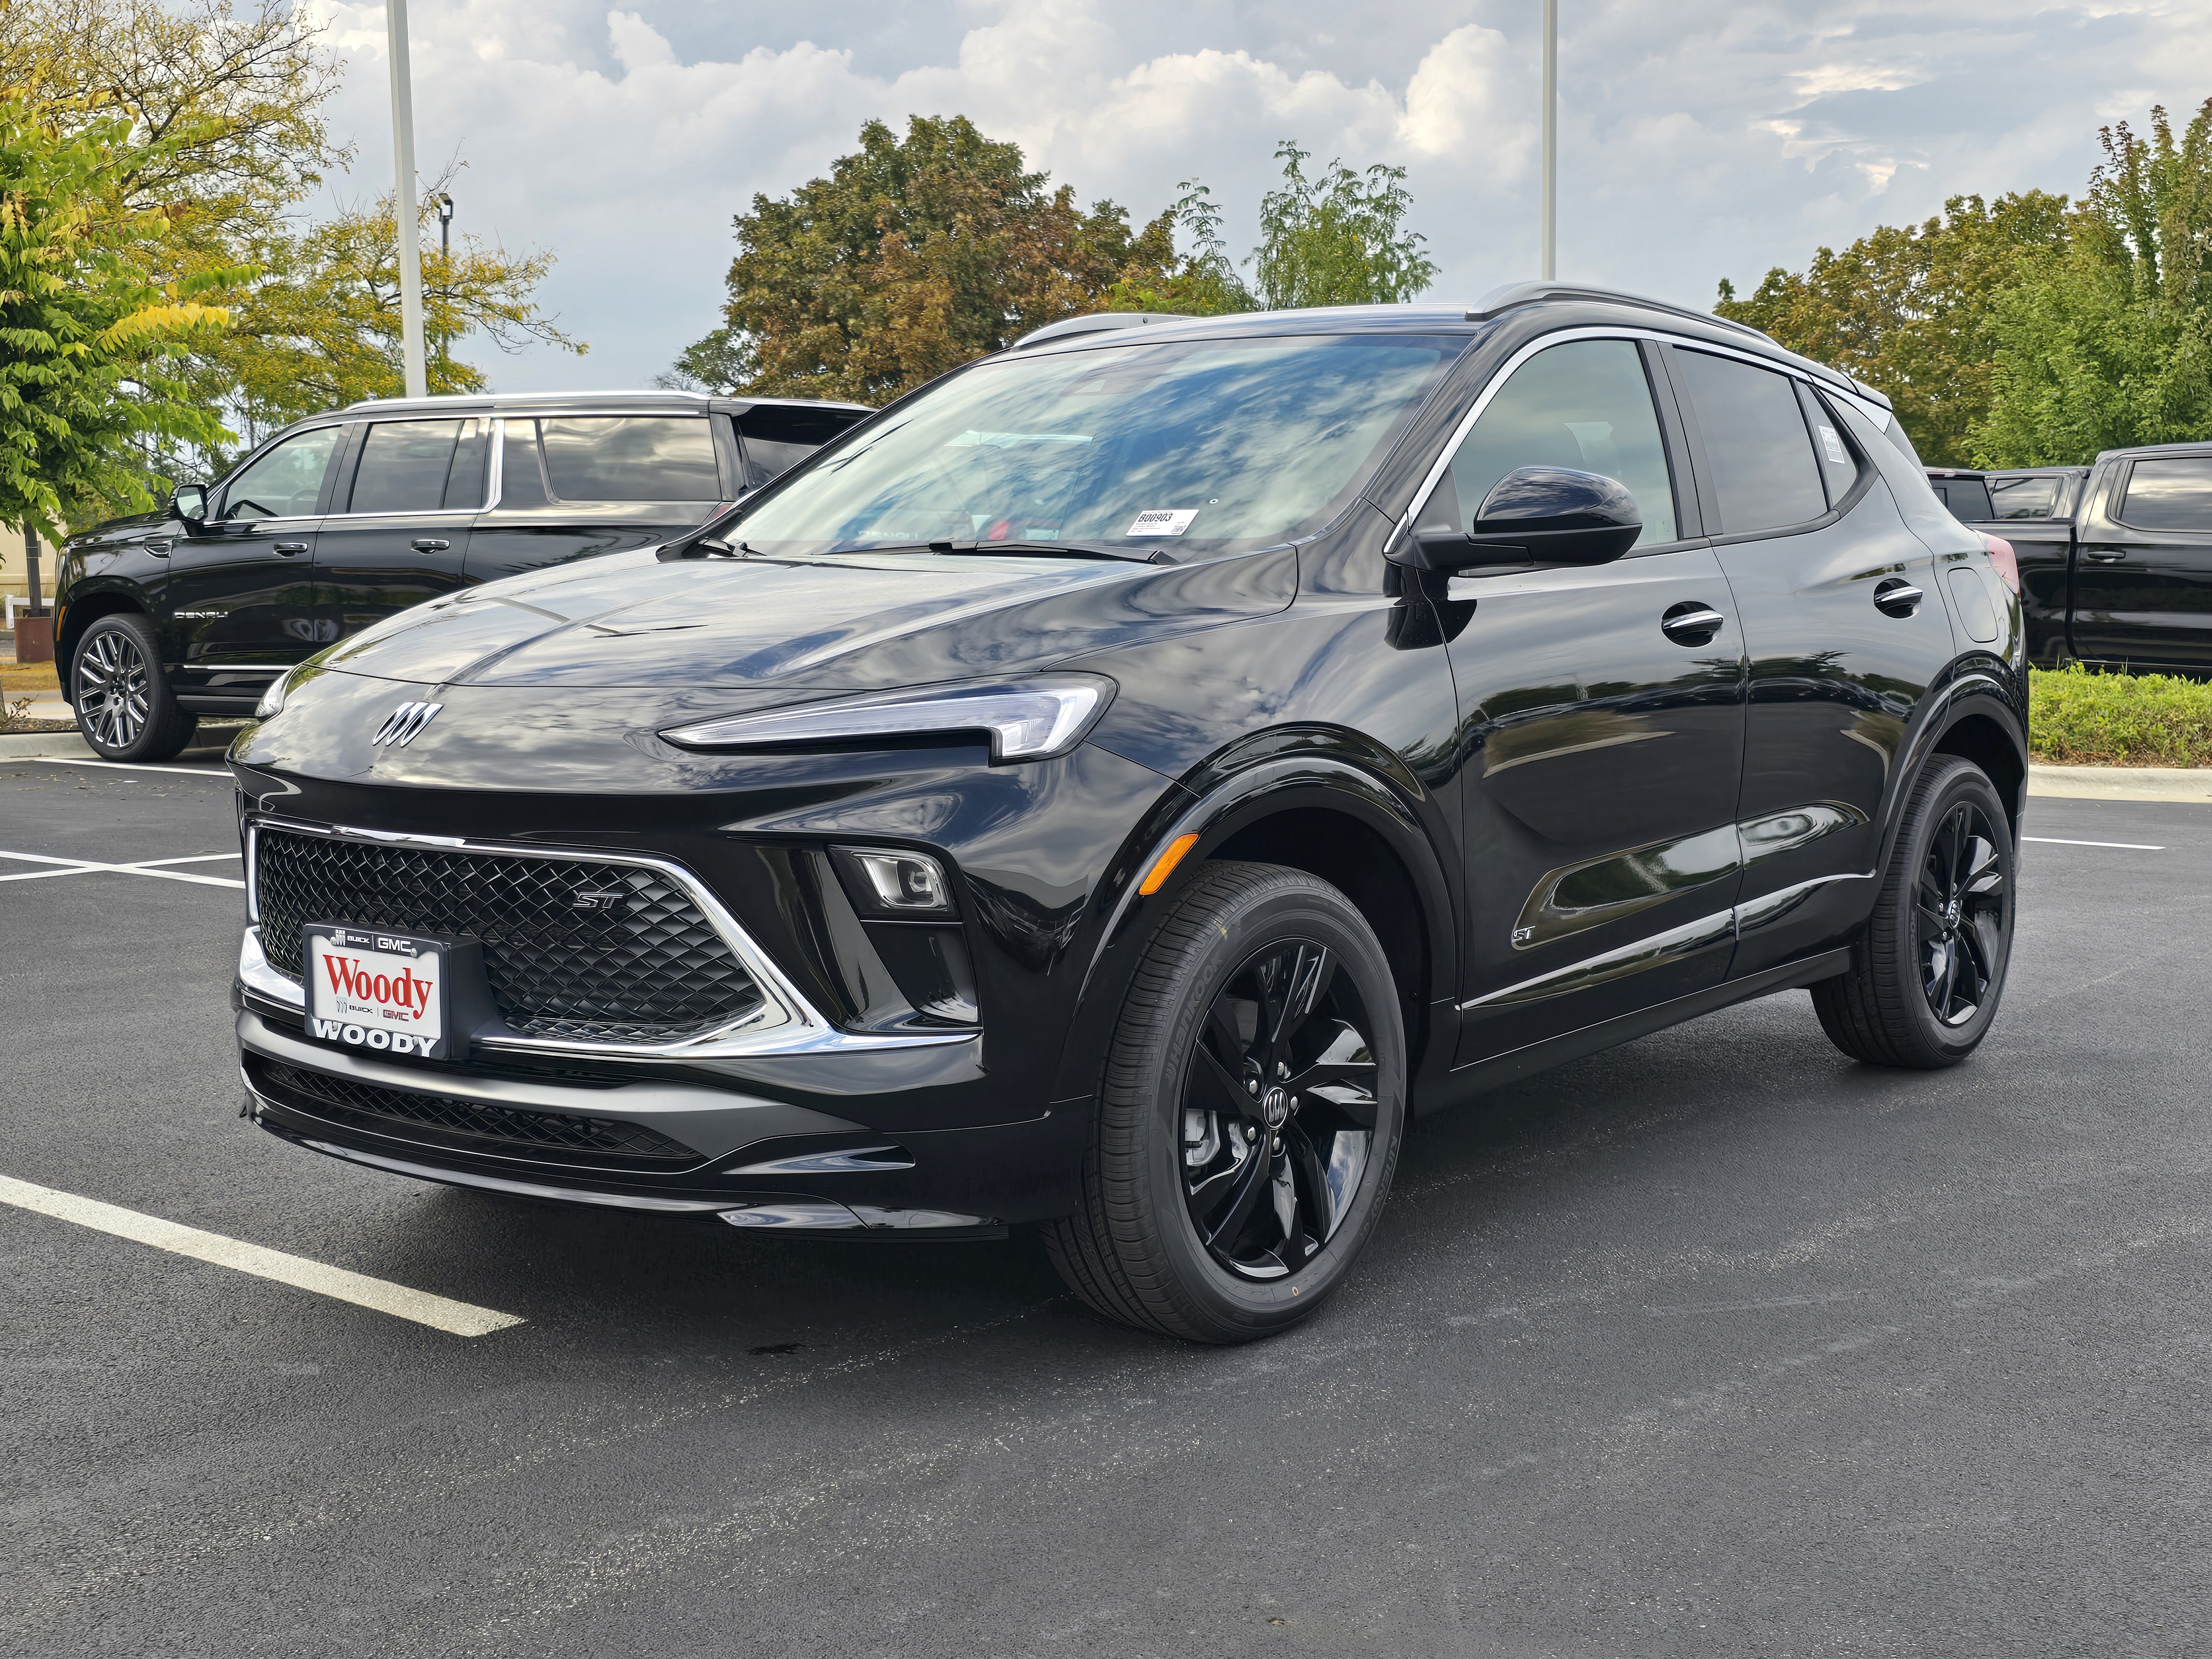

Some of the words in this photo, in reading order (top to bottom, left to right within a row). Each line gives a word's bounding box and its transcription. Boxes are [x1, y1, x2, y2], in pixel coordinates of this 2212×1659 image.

[573, 893, 624, 909] ST
[1511, 925, 1536, 943] ST
[347, 935, 370, 943] BUICK
[378, 937, 411, 952] GMC
[322, 954, 433, 1020] Woody
[349, 1005, 373, 1014] BUICK
[383, 1009, 409, 1021] GMC
[312, 1018, 438, 1057] WOODY
